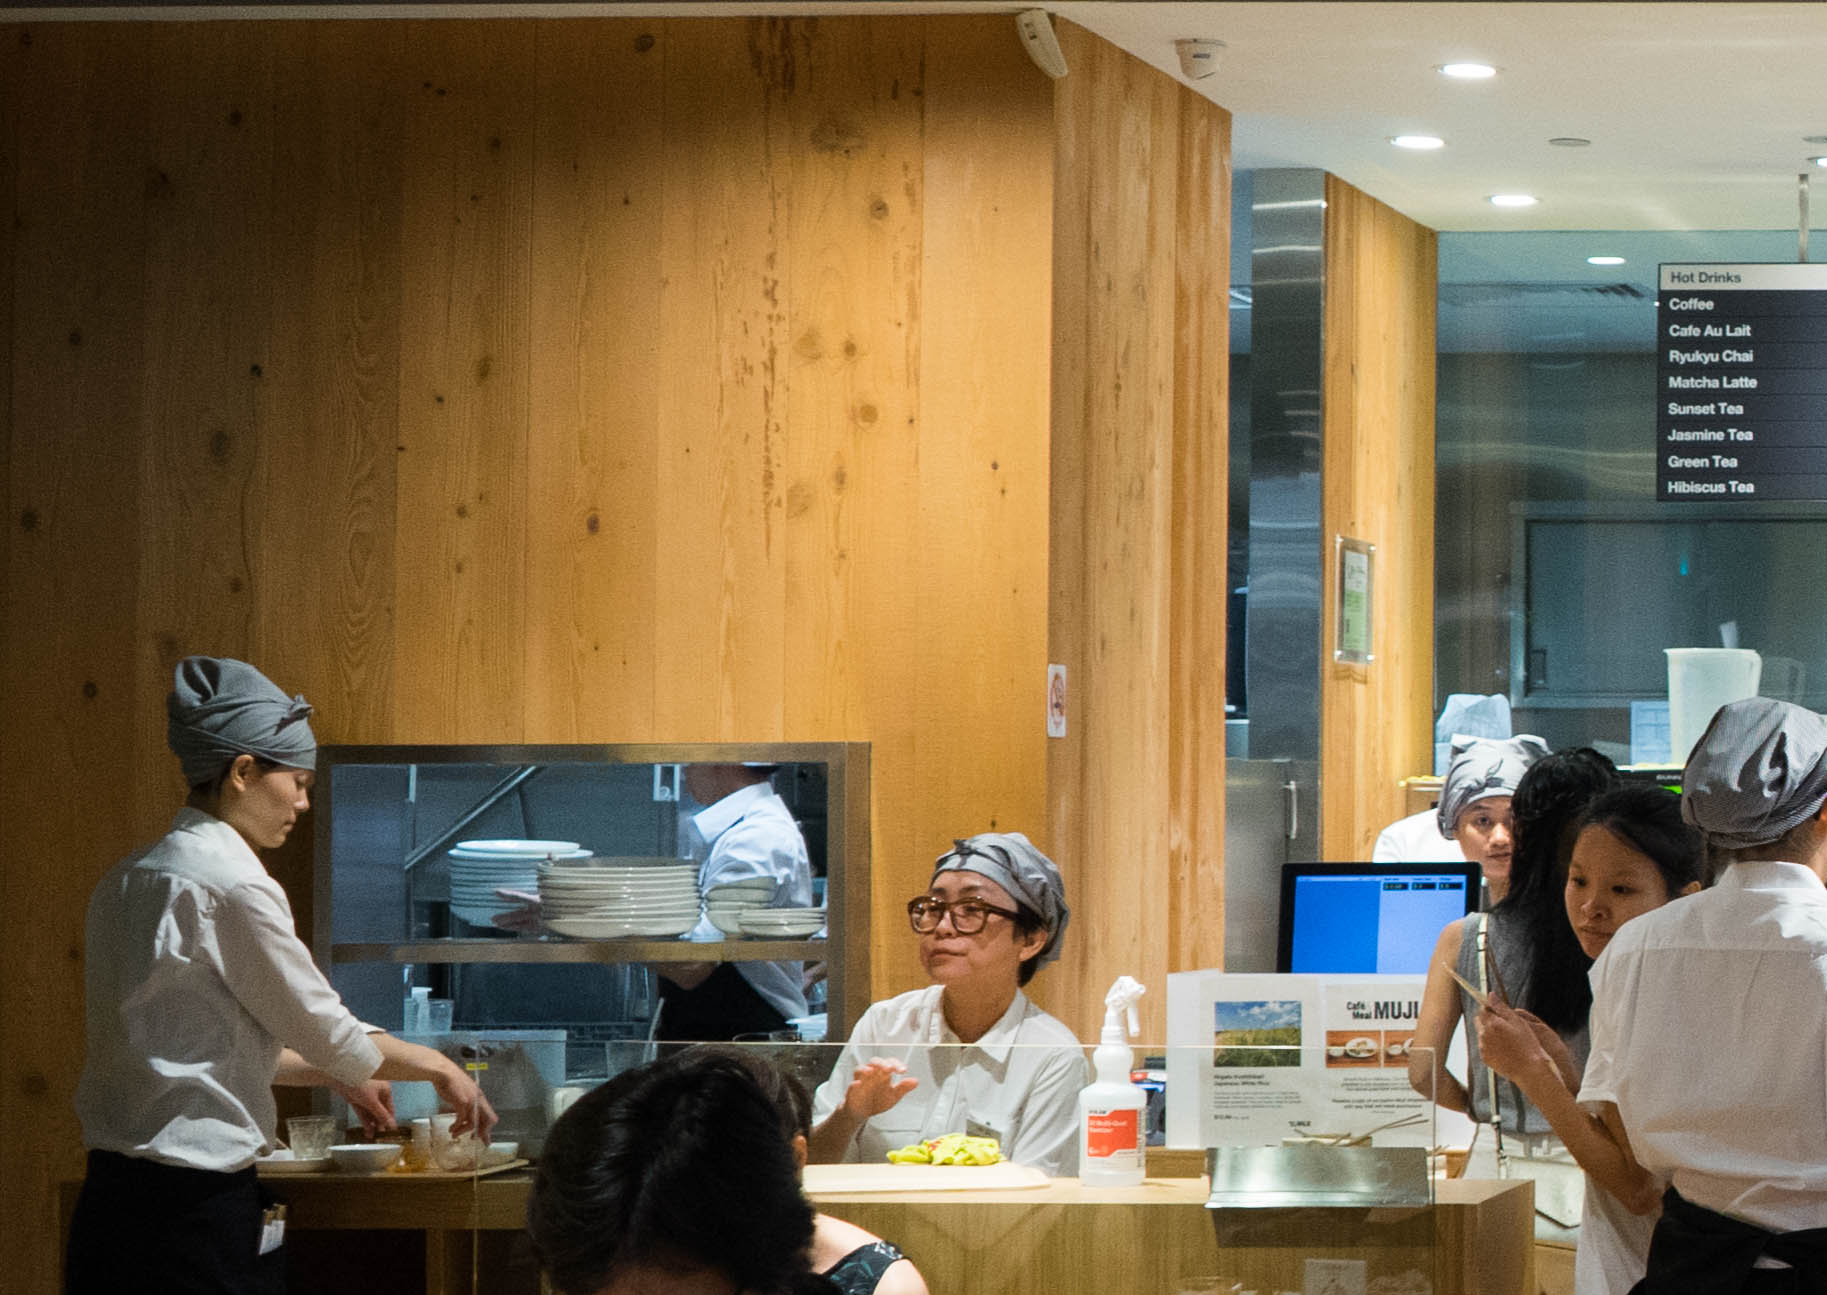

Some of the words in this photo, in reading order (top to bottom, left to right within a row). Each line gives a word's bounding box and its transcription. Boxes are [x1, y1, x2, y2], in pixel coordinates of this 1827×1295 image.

[1670, 271, 1695, 284] Hot
[1697, 271, 1742, 284] Drinks
[1668, 297, 1715, 311] Coffee
[1668, 323, 1702, 337] Cafe
[1703, 324, 1723, 337] Au
[1725, 323, 1752, 337] Lait
[1668, 349, 1720, 365] Ryukyu
[1721, 349, 1754, 363] Chai
[1668, 375, 1721, 389] Matcha
[1722, 375, 1759, 389] Latte
[1667, 402, 1716, 416] Sunset
[1717, 401, 1745, 415] Tea
[1667, 428, 1726, 442] Jasmine
[1726, 428, 1754, 442] Tea
[1667, 455, 1710, 469] Green
[1711, 454, 1739, 469] Tea
[1667, 480, 1727, 494] Hibiscus
[1727, 480, 1755, 494] Tea
[1346, 1001, 1366, 1011] Café
[1374, 1001, 1419, 1020] MUJI
[1352, 1011, 1373, 1020] Meal
